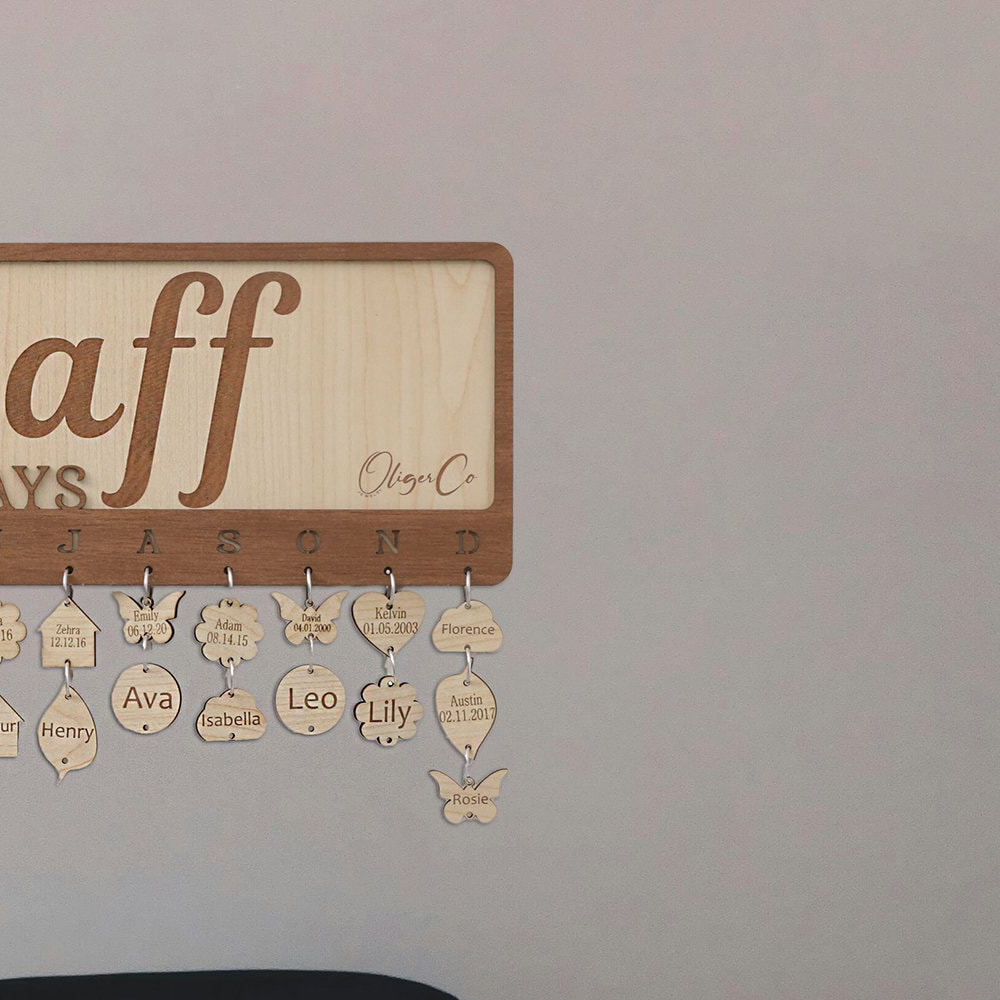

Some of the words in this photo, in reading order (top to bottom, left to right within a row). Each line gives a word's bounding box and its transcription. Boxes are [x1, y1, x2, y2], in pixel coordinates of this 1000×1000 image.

[57, 528, 82, 554] J
[136, 528, 162, 554] A
[216, 528, 241, 554] S
[295, 528, 321, 554] O
[375, 528, 400, 554] N
[455, 528, 480, 554] D
[133, 610, 159, 622] Emily
[302, 614, 322, 622] David
[375, 606, 407, 620] Kelvin
[56, 624, 80, 635] Zehra
[215, 618, 242, 632] Adam
[294, 623, 332, 632] 04.01.2000
[363, 622, 419, 634] 01.05.2003
[441, 623, 495, 635] Florence
[50, 637, 86, 648] 12.12.16
[206, 632, 248, 647] 08.14.15
[122, 686, 173, 710] Ava
[289, 688, 338, 710] Leo
[450, 694, 482, 706] Austin
[202, 712, 261, 728] Isabella
[369, 699, 412, 729] Lily
[439, 707, 496, 723] 02.11.2017
[42, 722, 95, 744] Henry
[452, 793, 488, 804] Rosie
